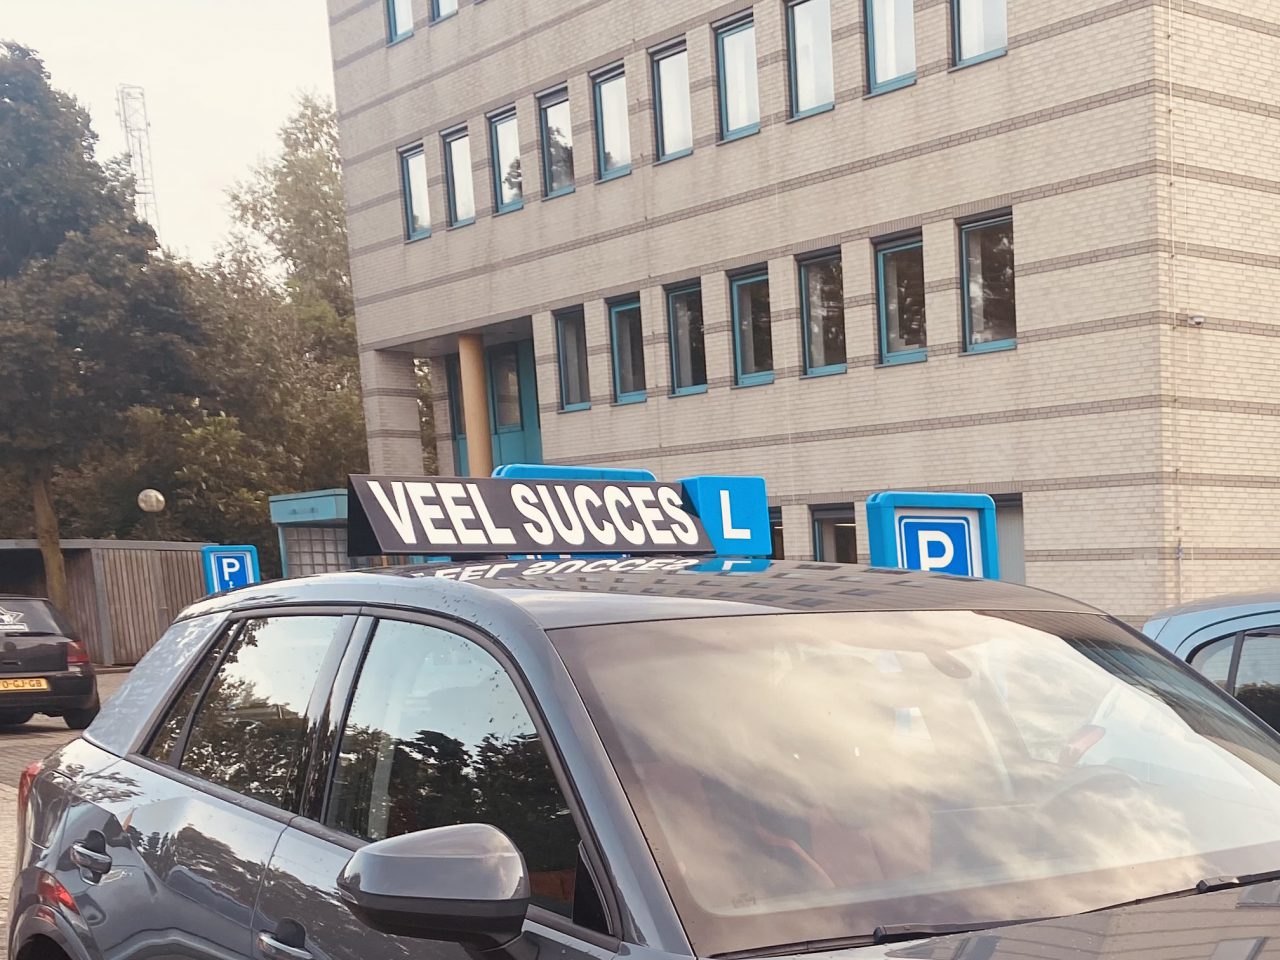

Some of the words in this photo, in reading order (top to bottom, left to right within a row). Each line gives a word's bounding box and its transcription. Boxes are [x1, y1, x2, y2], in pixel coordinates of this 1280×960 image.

[366, 480, 517, 546] VEEL
[510, 482, 699, 546] SUCCES
[719, 489, 751, 540] L
[222, 557, 240, 581] P
[918, 530, 955, 572] P
[0, 679, 42, 689] 0-GJ-GB
